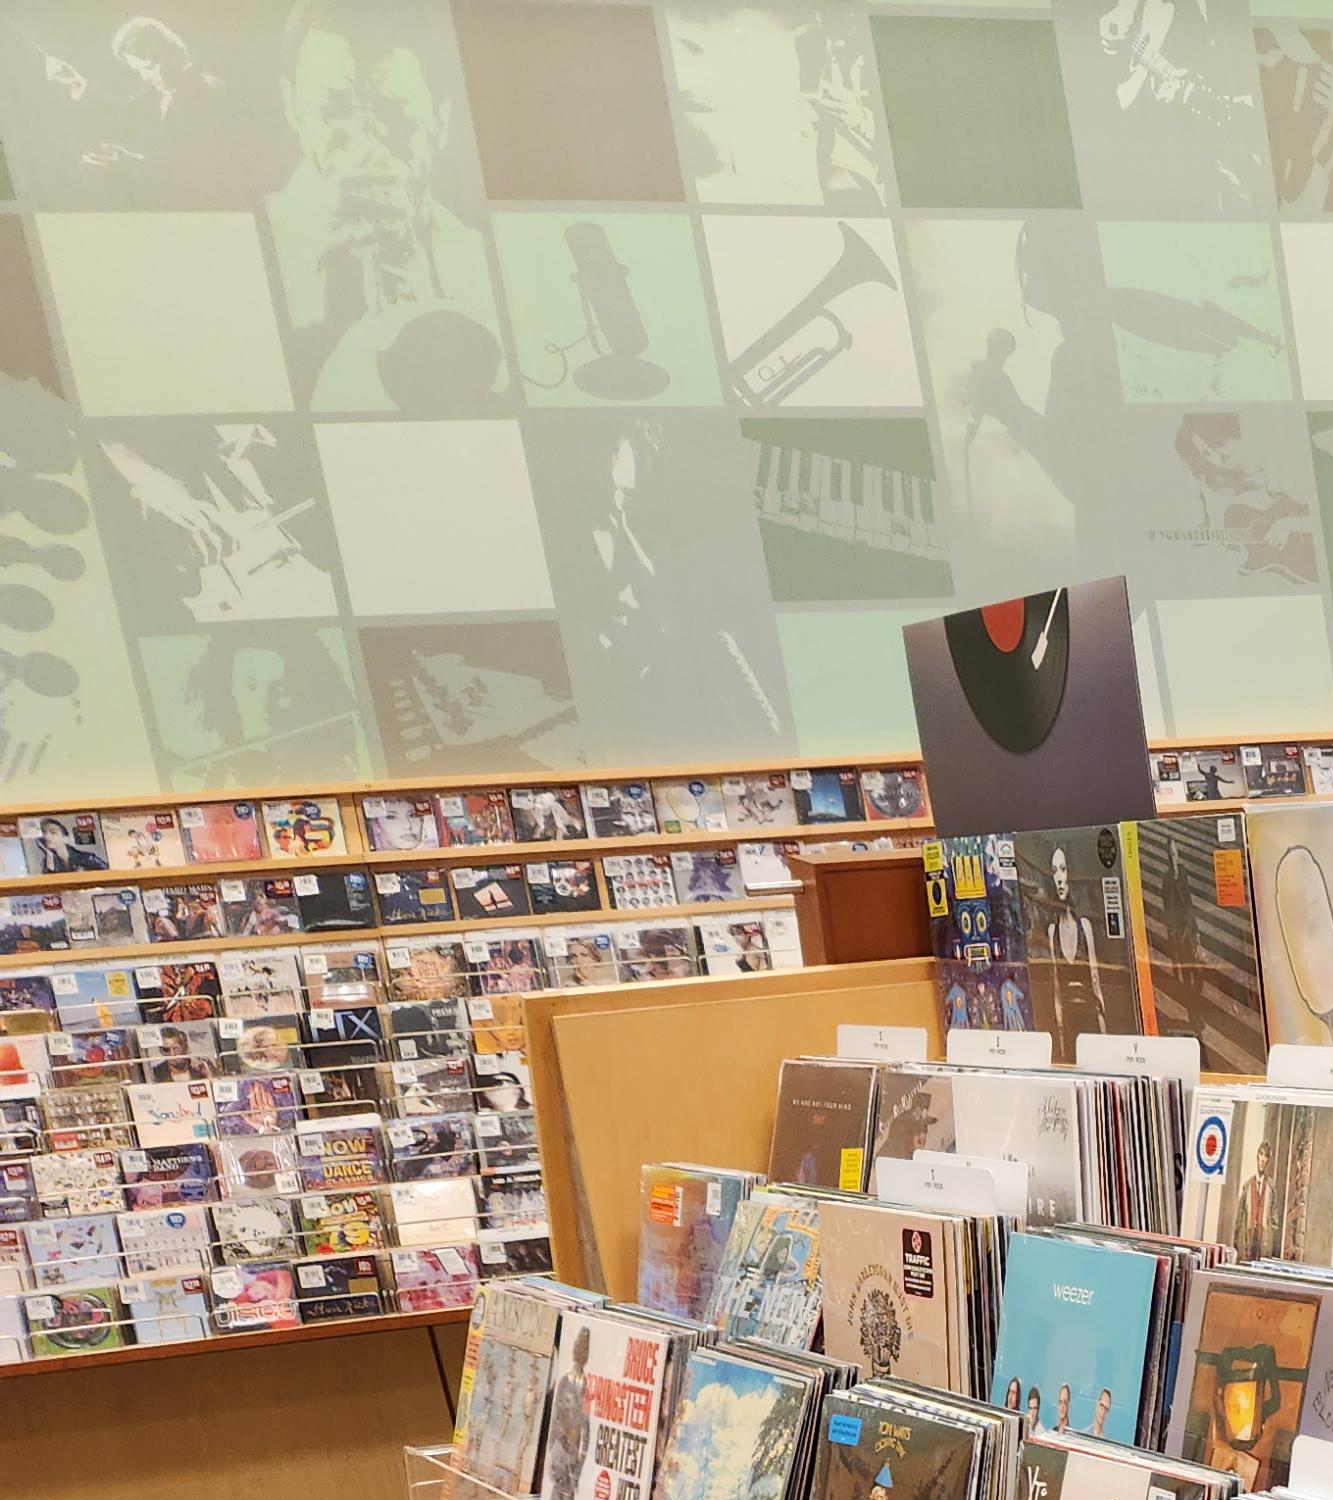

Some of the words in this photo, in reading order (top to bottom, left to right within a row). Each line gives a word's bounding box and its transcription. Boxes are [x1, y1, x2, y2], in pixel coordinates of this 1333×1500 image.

[323, 1138, 367, 1156] NOW
[323, 1161, 373, 1178] DANCE
[904, 1253, 931, 1267] TRAFFIC
[1052, 1281, 1095, 1306] weezer
[623, 1336, 661, 1386] BRUCE
[594, 1423, 648, 1480] GREATEST
